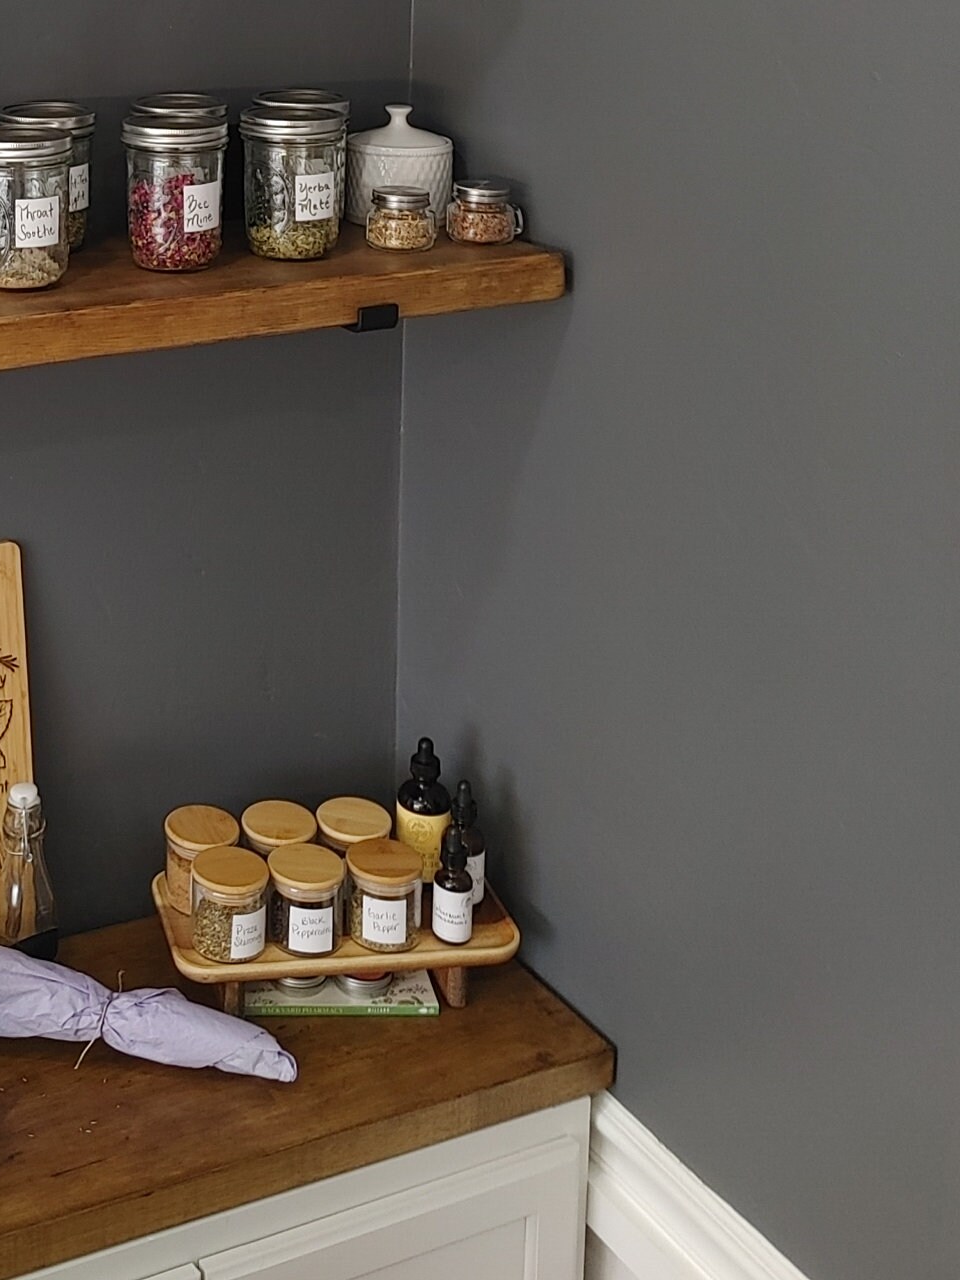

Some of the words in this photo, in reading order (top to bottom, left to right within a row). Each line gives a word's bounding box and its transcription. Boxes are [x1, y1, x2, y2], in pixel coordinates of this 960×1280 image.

[299, 182, 331, 202] Yerba
[16, 202, 54, 221] Throat
[186, 194, 210, 215] Bee
[186, 212, 213, 228] Mine
[16, 224, 56, 241] Soothe
[301, 916, 325, 926] Black
[368, 907, 397, 921] Garlic
[373, 921, 400, 934] Pepper
